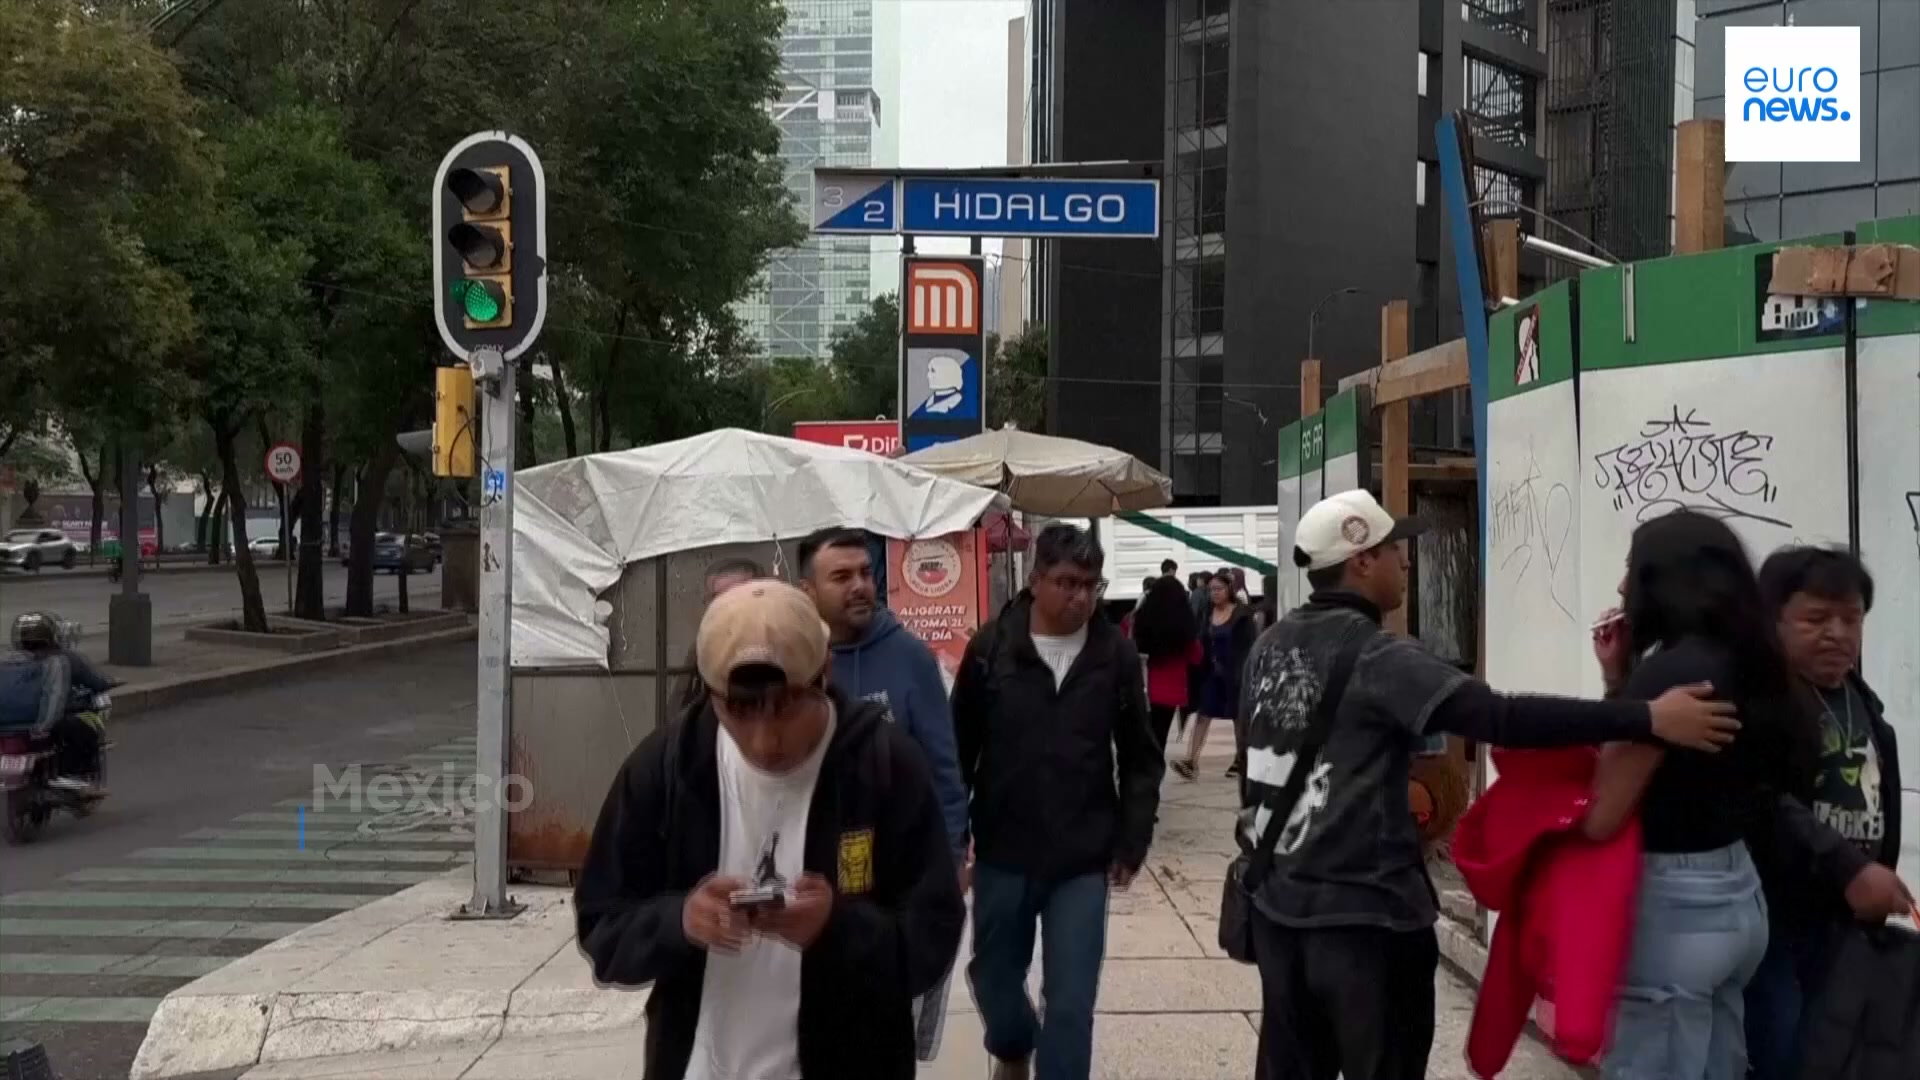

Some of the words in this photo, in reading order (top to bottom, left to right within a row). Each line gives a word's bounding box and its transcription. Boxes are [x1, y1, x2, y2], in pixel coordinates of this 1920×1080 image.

[823, 186, 843, 208] 3
[863, 201, 885, 223] 2
[933, 191, 1126, 224] HIDALGO
[275, 451, 293, 465] 50
[900, 603, 966, 616] ALIGÉRATE
[902, 617, 912, 627] Y
[913, 617, 949, 627] TOMA
[951, 617, 964, 627] 2L
[931, 628, 952, 640] DÍA
